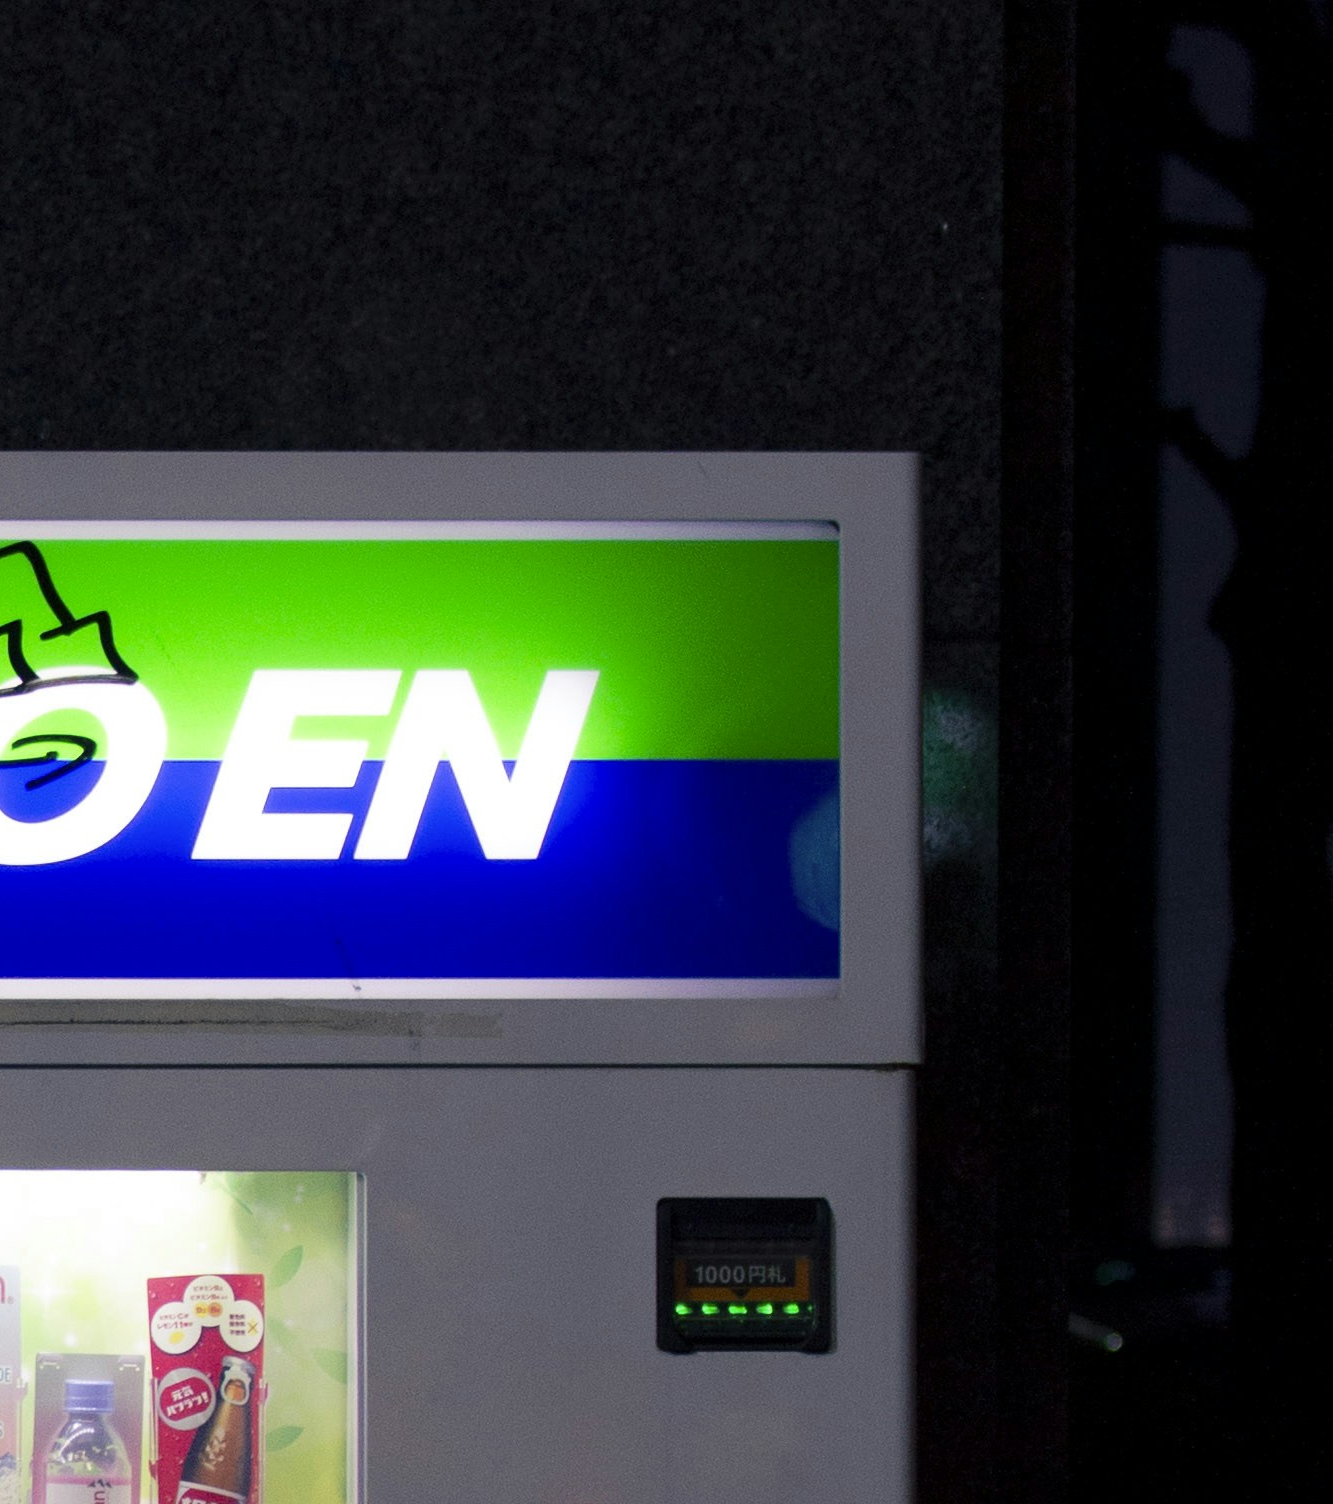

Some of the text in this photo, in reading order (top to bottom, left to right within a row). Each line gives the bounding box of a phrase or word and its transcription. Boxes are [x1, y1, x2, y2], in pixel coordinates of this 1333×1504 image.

[191, 668, 600, 862] EN
[694, 1264, 787, 1285] 1000円札
[170, 1385, 194, 1401] 元気
